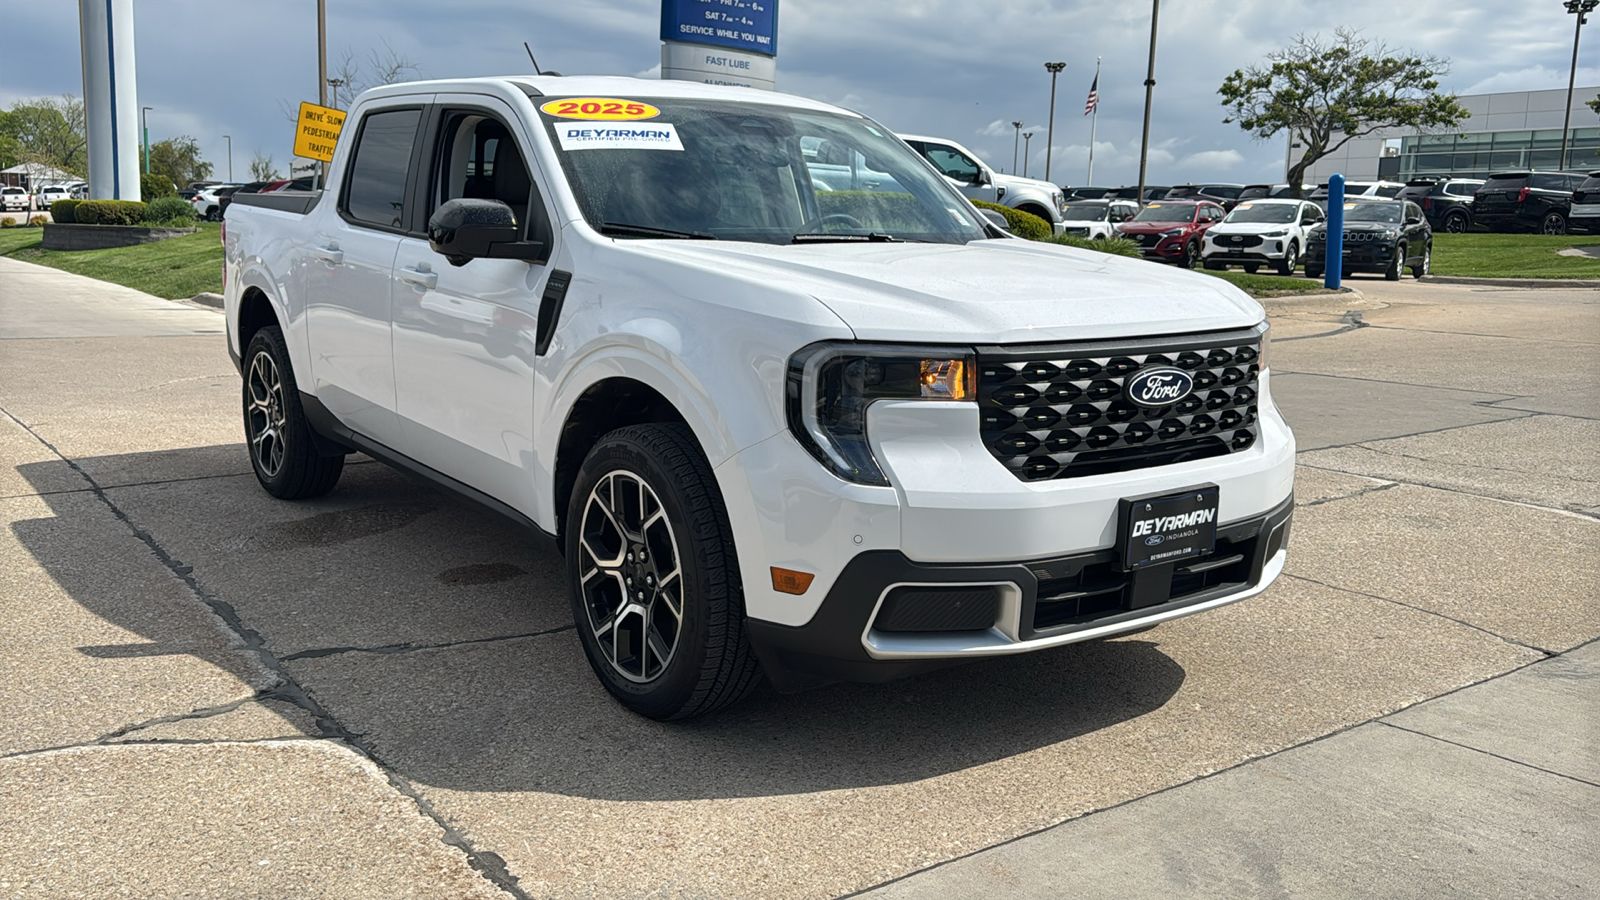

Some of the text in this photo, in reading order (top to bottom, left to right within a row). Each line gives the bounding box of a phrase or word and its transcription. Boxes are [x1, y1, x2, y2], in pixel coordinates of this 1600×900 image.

[705, 11, 720, 20] SAT
[680, 24, 771, 45] SERVICE WHILE YOU WAIT
[705, 55, 751, 70] FAST LUBE
[557, 102, 645, 115] 2025
[306, 111, 323, 122] DRIVE
[567, 129, 670, 138] DEYARMAN
[308, 142, 333, 155] TRAFFIC
[1142, 376, 1182, 399] Ford
[1132, 508, 1215, 537] DEYARMAN
[1165, 529, 1199, 541] INDIANOLA
